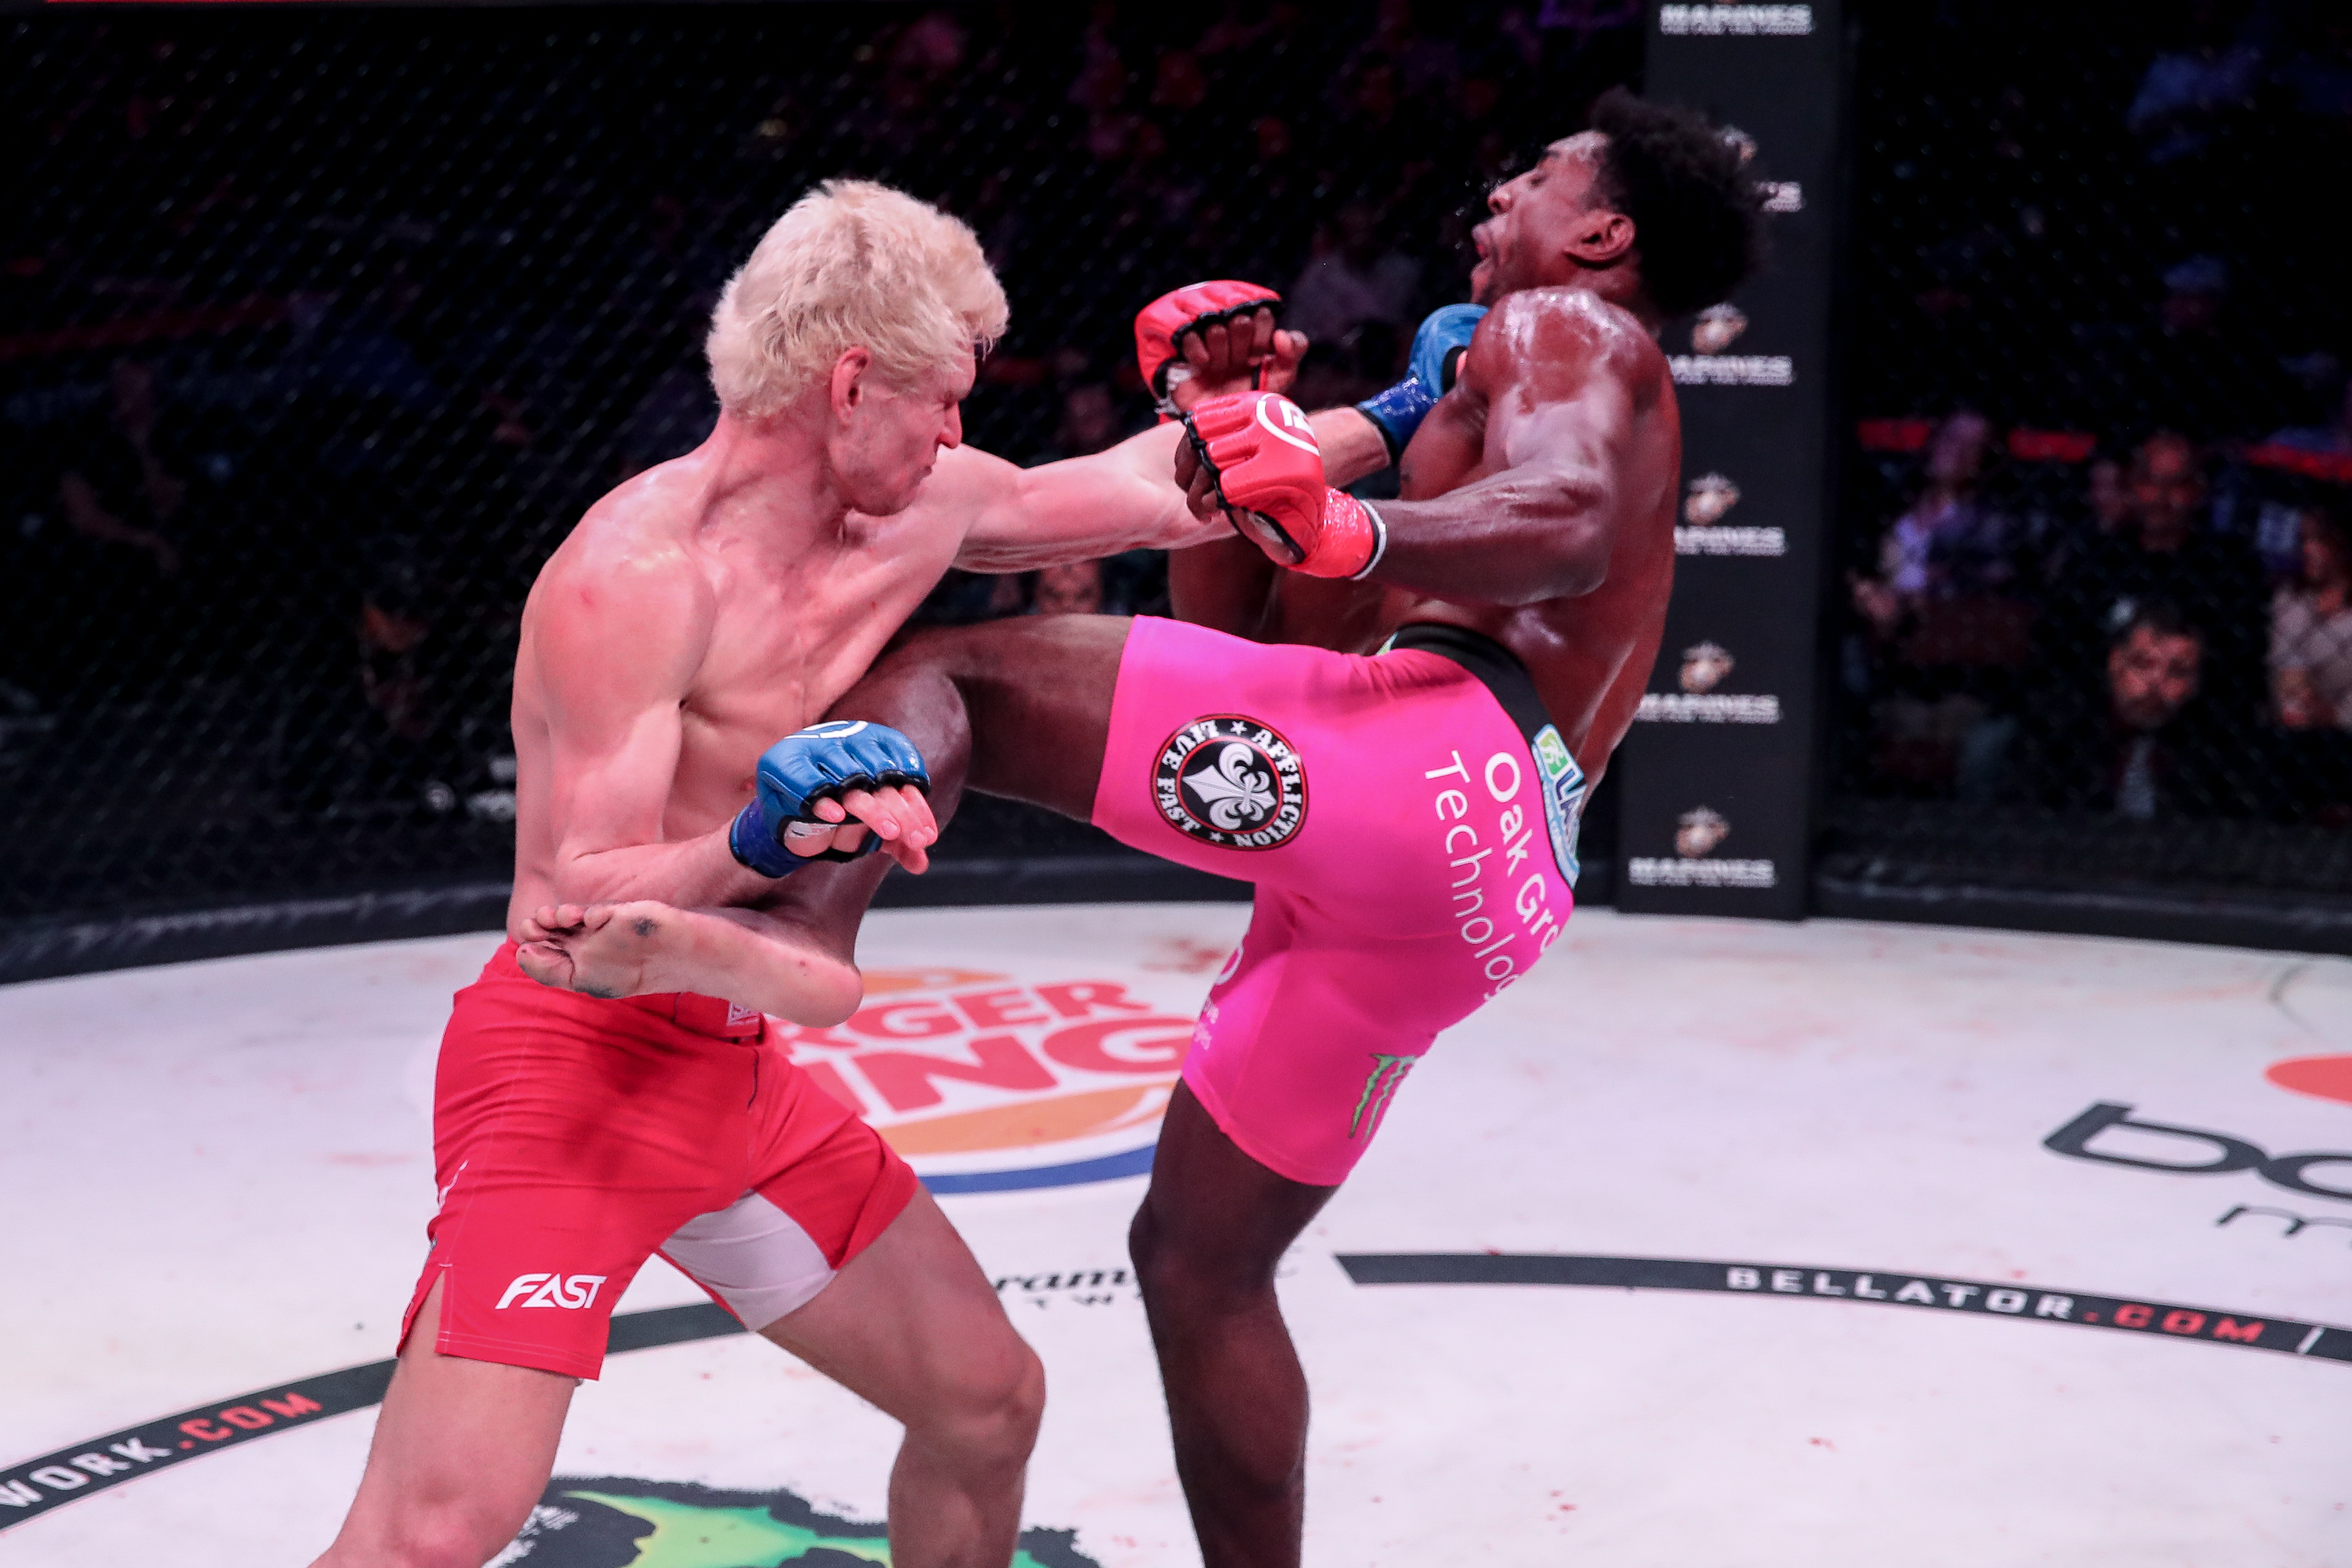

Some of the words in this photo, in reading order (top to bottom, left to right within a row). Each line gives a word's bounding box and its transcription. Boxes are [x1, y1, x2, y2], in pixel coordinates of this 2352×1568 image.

[1162, 720, 1221, 771] LIVE
[1156, 777, 1202, 832] FAST
[1234, 728, 1302, 848] AFFLICTION
[1485, 751, 1533, 878] Oak
[495, 1272, 608, 1310] FAST
[1725, 1266, 2266, 1345] BELLATOR.COM
